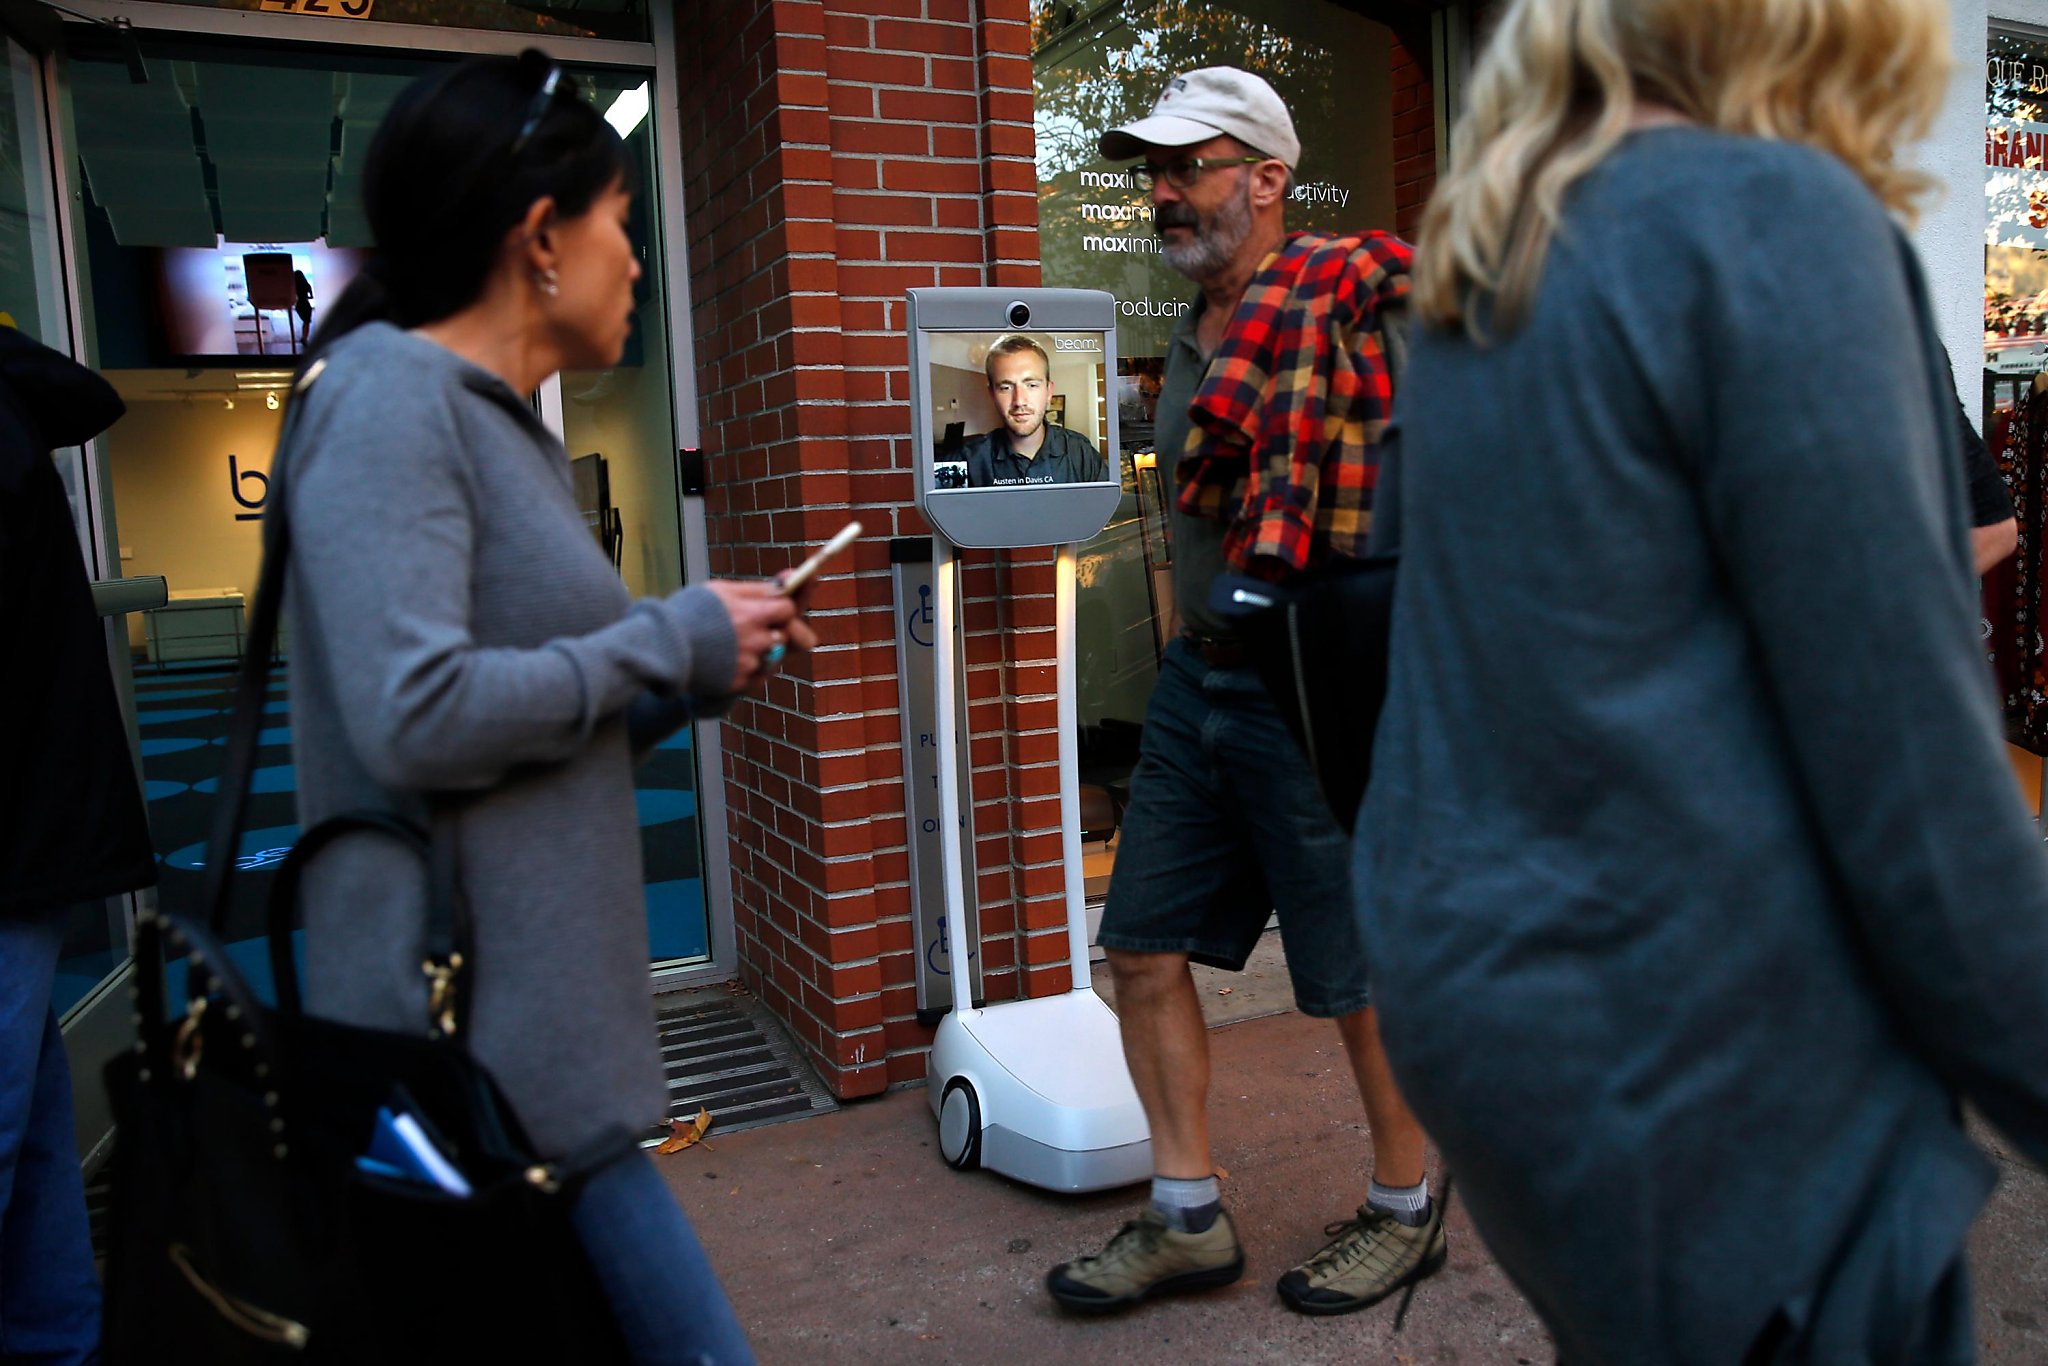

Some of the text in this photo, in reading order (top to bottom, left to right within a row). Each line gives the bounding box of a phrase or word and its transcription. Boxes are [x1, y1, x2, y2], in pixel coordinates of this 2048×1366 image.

[2033, 64, 2048, 91] R
[1985, 126, 2048, 172] RAN
[1054, 335, 1097, 350] beam
[1025, 476, 1043, 484] Davis
[1044, 475, 1054, 483] CA
